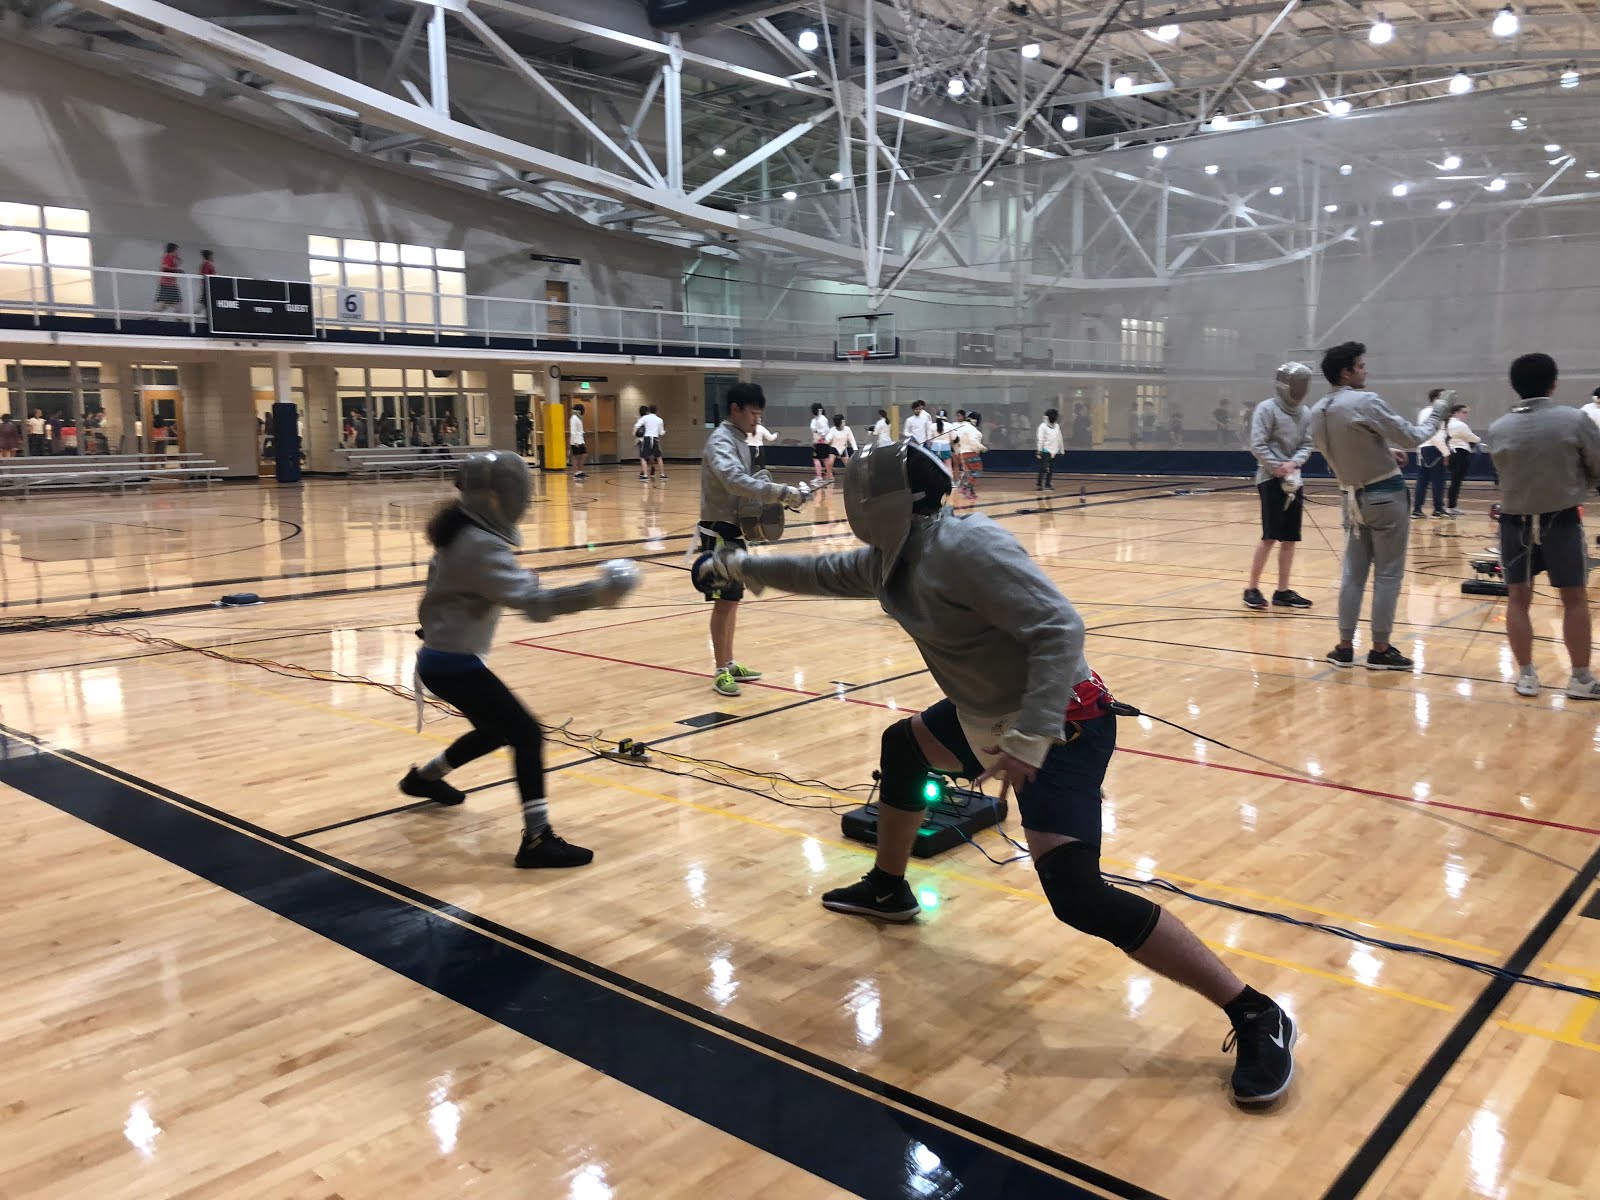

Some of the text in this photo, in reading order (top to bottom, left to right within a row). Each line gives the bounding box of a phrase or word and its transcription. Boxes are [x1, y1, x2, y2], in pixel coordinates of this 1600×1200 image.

[217, 300, 239, 308] HOME
[345, 294, 358, 313] 6
[286, 304, 309, 312] GUEST
